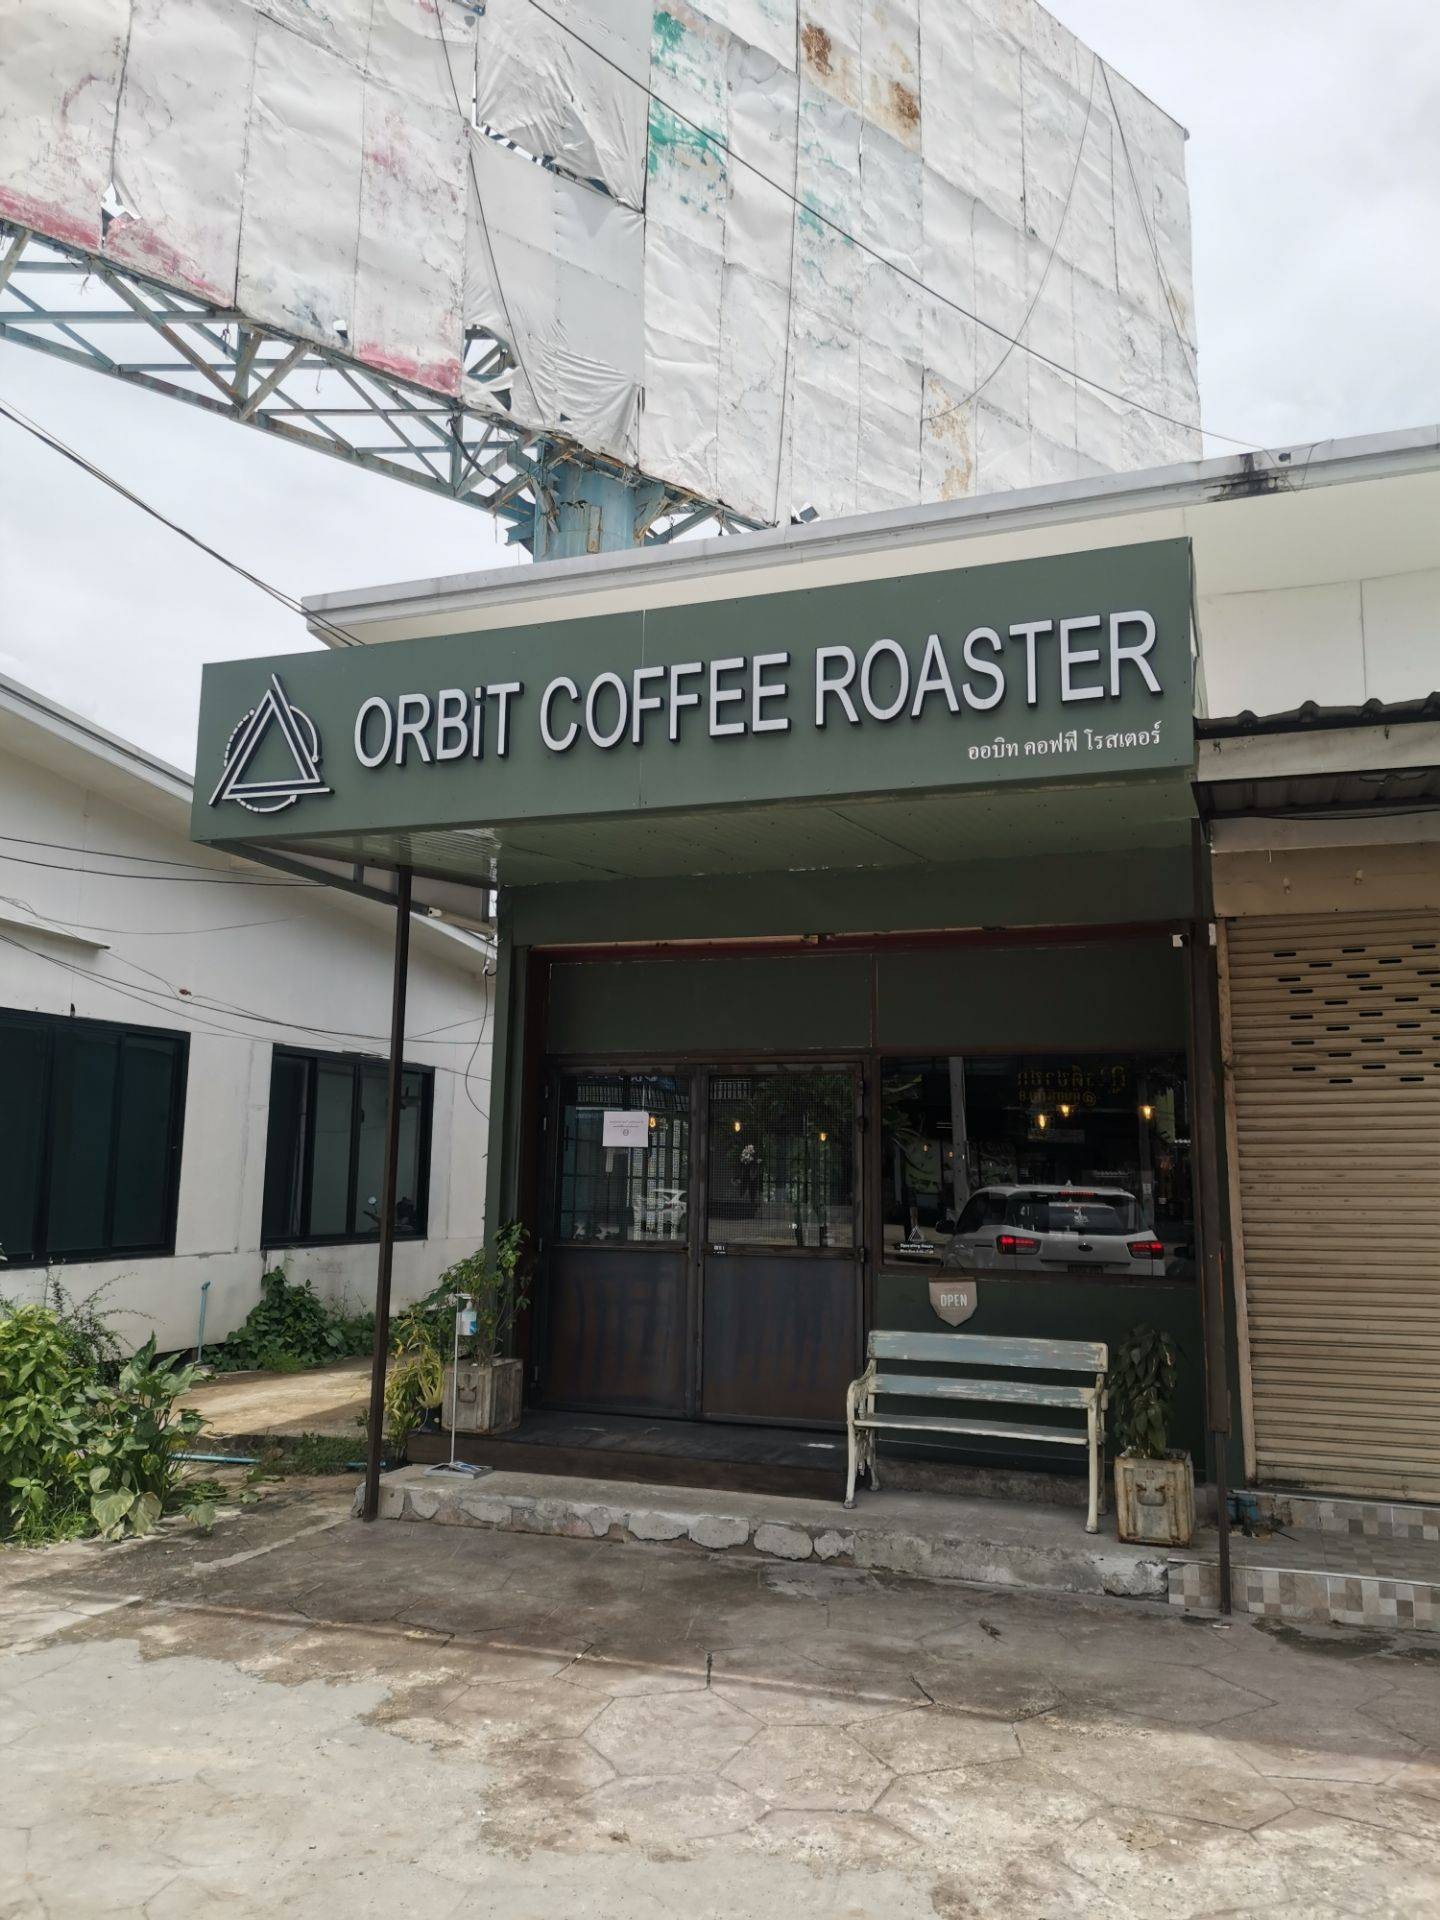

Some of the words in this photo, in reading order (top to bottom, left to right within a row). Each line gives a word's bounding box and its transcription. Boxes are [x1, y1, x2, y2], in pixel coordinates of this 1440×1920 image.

[354, 681, 524, 769] ORBiT
[539, 652, 790, 753] COFFEE
[815, 609, 1163, 729] ROASTER
[968, 736, 1019, 760] ออบิท
[1024, 730, 1078, 757] คอฟฟี
[1084, 720, 1162, 751] โรสเตอร์
[940, 1293, 968, 1308] OPEN
